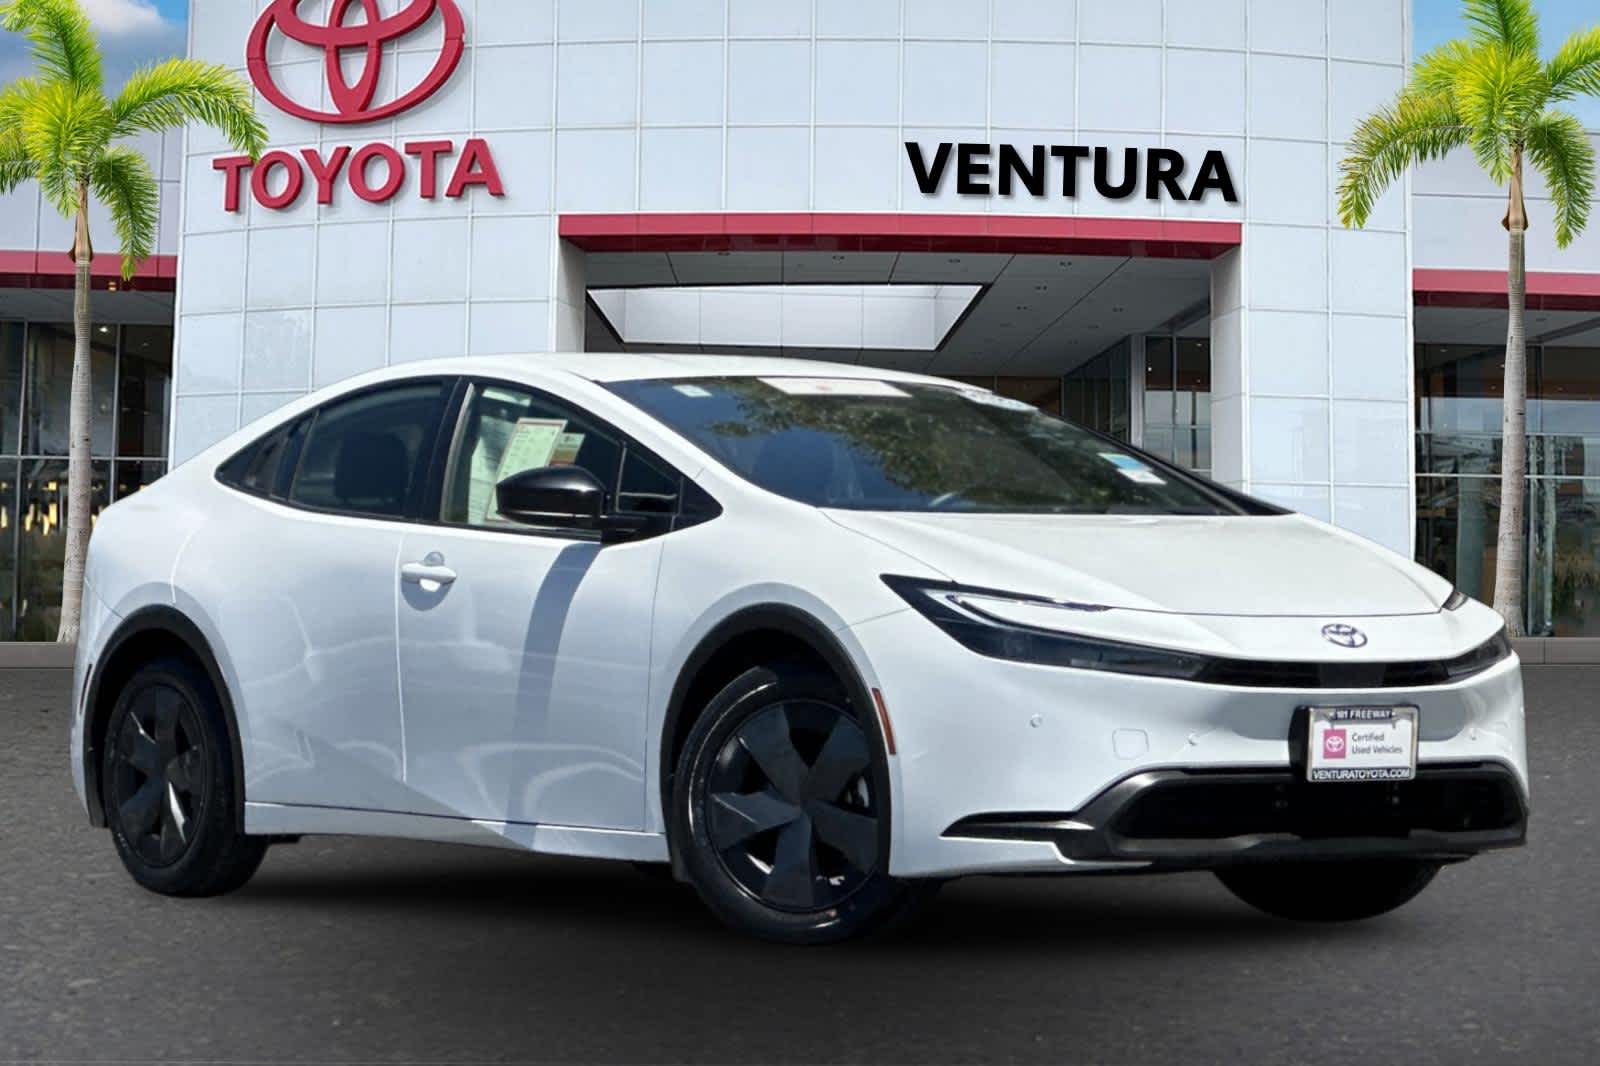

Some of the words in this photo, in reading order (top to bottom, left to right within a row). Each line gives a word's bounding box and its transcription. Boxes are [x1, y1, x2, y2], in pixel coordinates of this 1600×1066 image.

[212, 138, 505, 212] TOYOTA
[905, 142, 1238, 203] VENTURA
[1352, 732, 1384, 741] Certified
[1352, 744, 1371, 754] Used
[1373, 745, 1403, 754] Vehicles
[1313, 769, 1409, 779] VENTURATOYOTA.COM
